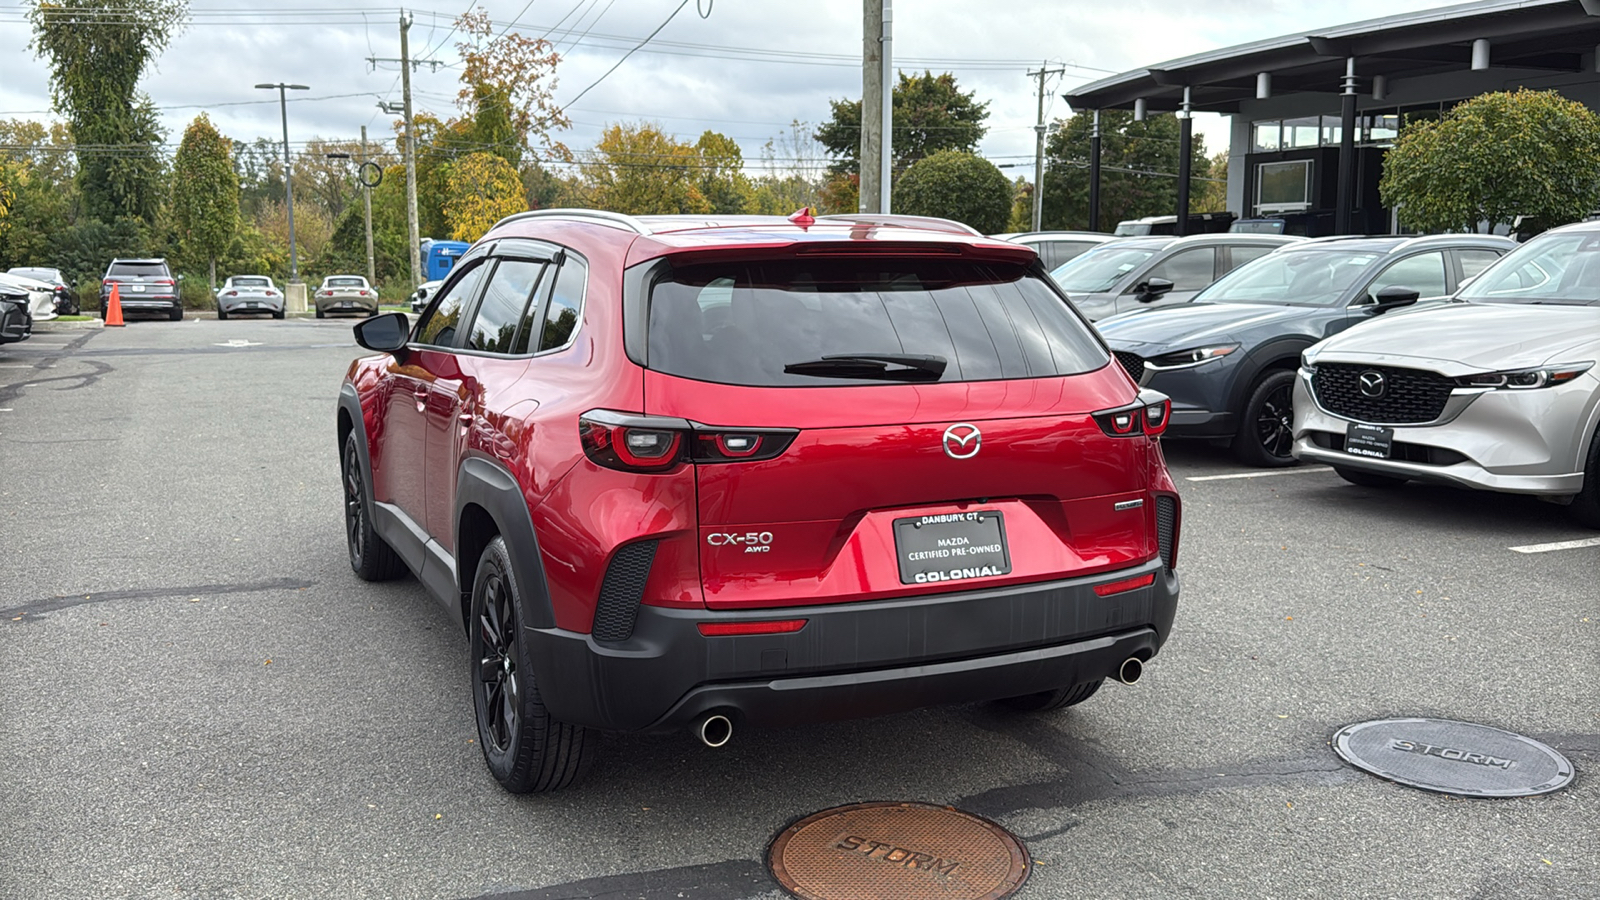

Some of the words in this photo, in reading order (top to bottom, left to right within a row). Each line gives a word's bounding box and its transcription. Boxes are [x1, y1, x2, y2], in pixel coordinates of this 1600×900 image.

[1347, 447, 1384, 457] COLONIAL
[966, 512, 978, 521] CT
[707, 531, 774, 546] CX-50
[937, 536, 970, 547] MAZDA
[744, 545, 770, 553] AWD
[908, 549, 949, 561] CERTIFIED
[951, 544, 1001, 557] PRE-OWNED
[915, 565, 1002, 583] COLONIAL
[1390, 739, 1515, 770] STORM
[836, 835, 960, 876] STORM
